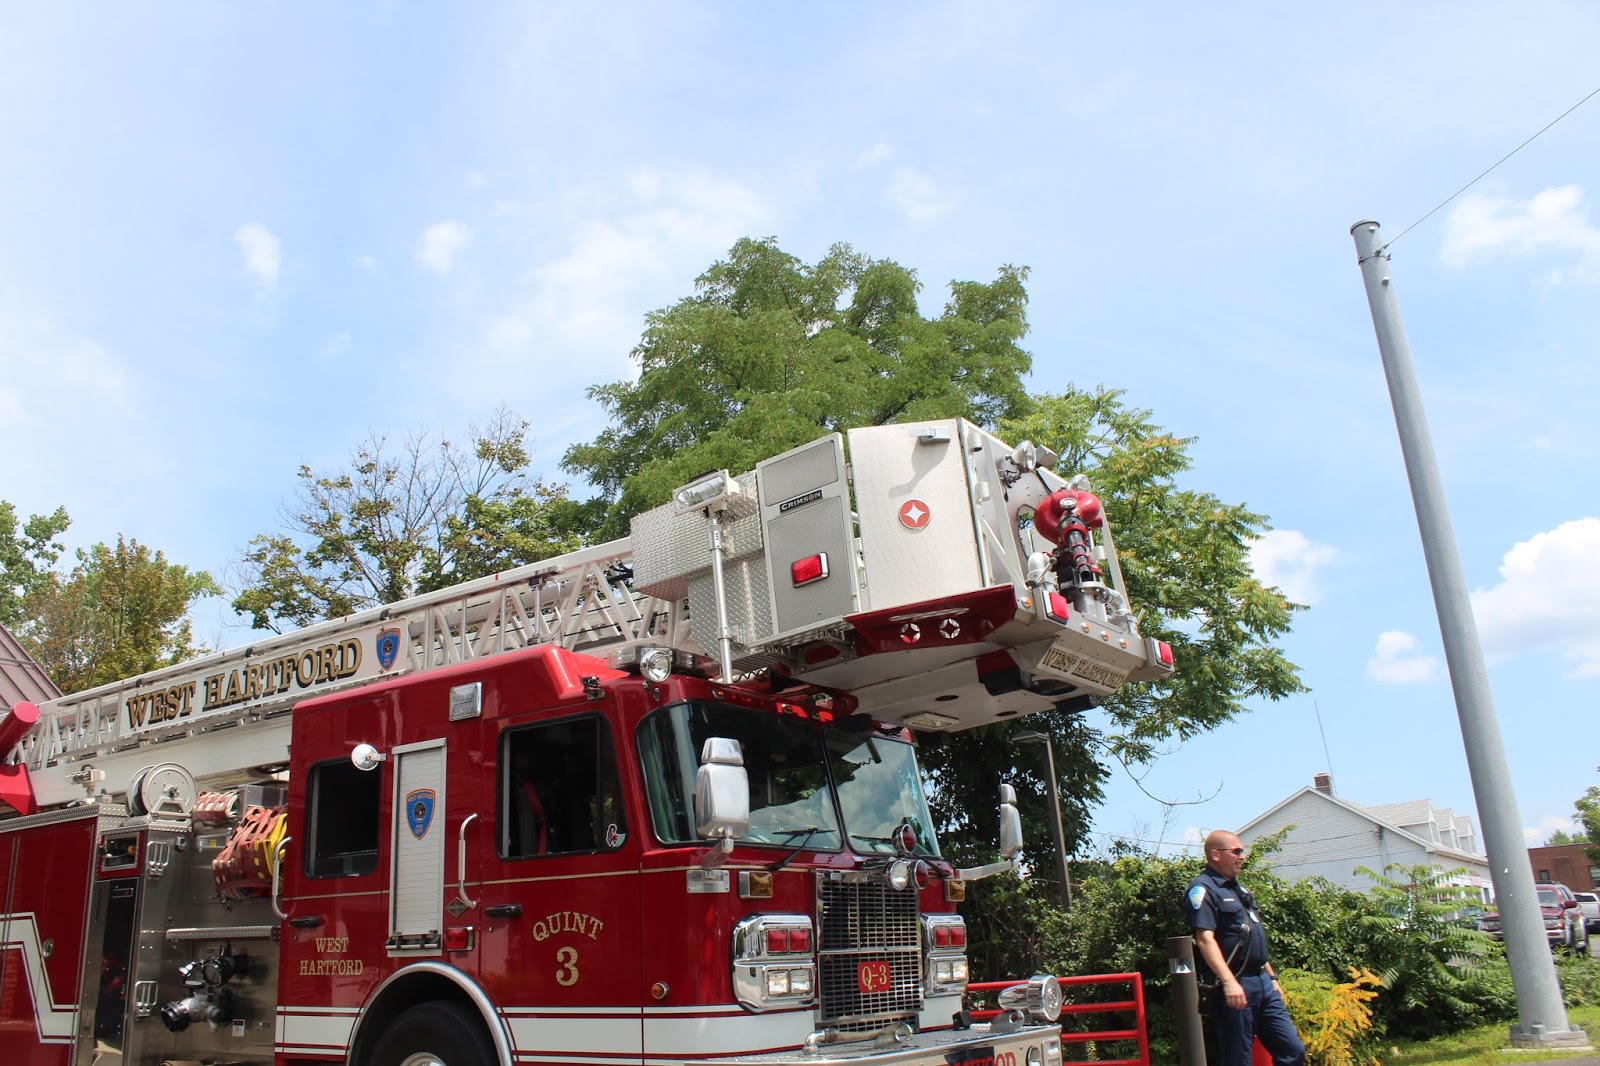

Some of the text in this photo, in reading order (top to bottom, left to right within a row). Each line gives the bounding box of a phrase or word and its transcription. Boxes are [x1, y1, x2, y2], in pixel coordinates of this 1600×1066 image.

[781, 491, 821, 510] CRIMSON
[126, 637, 363, 728] WEST HARTFORD
[1042, 647, 1125, 689] WEST HARTFORD
[532, 911, 603, 942] QUINT
[315, 937, 349, 953] WEST
[299, 959, 364, 976] HARTFORD
[555, 946, 579, 986] 3
[861, 964, 888, 991] Q-3
